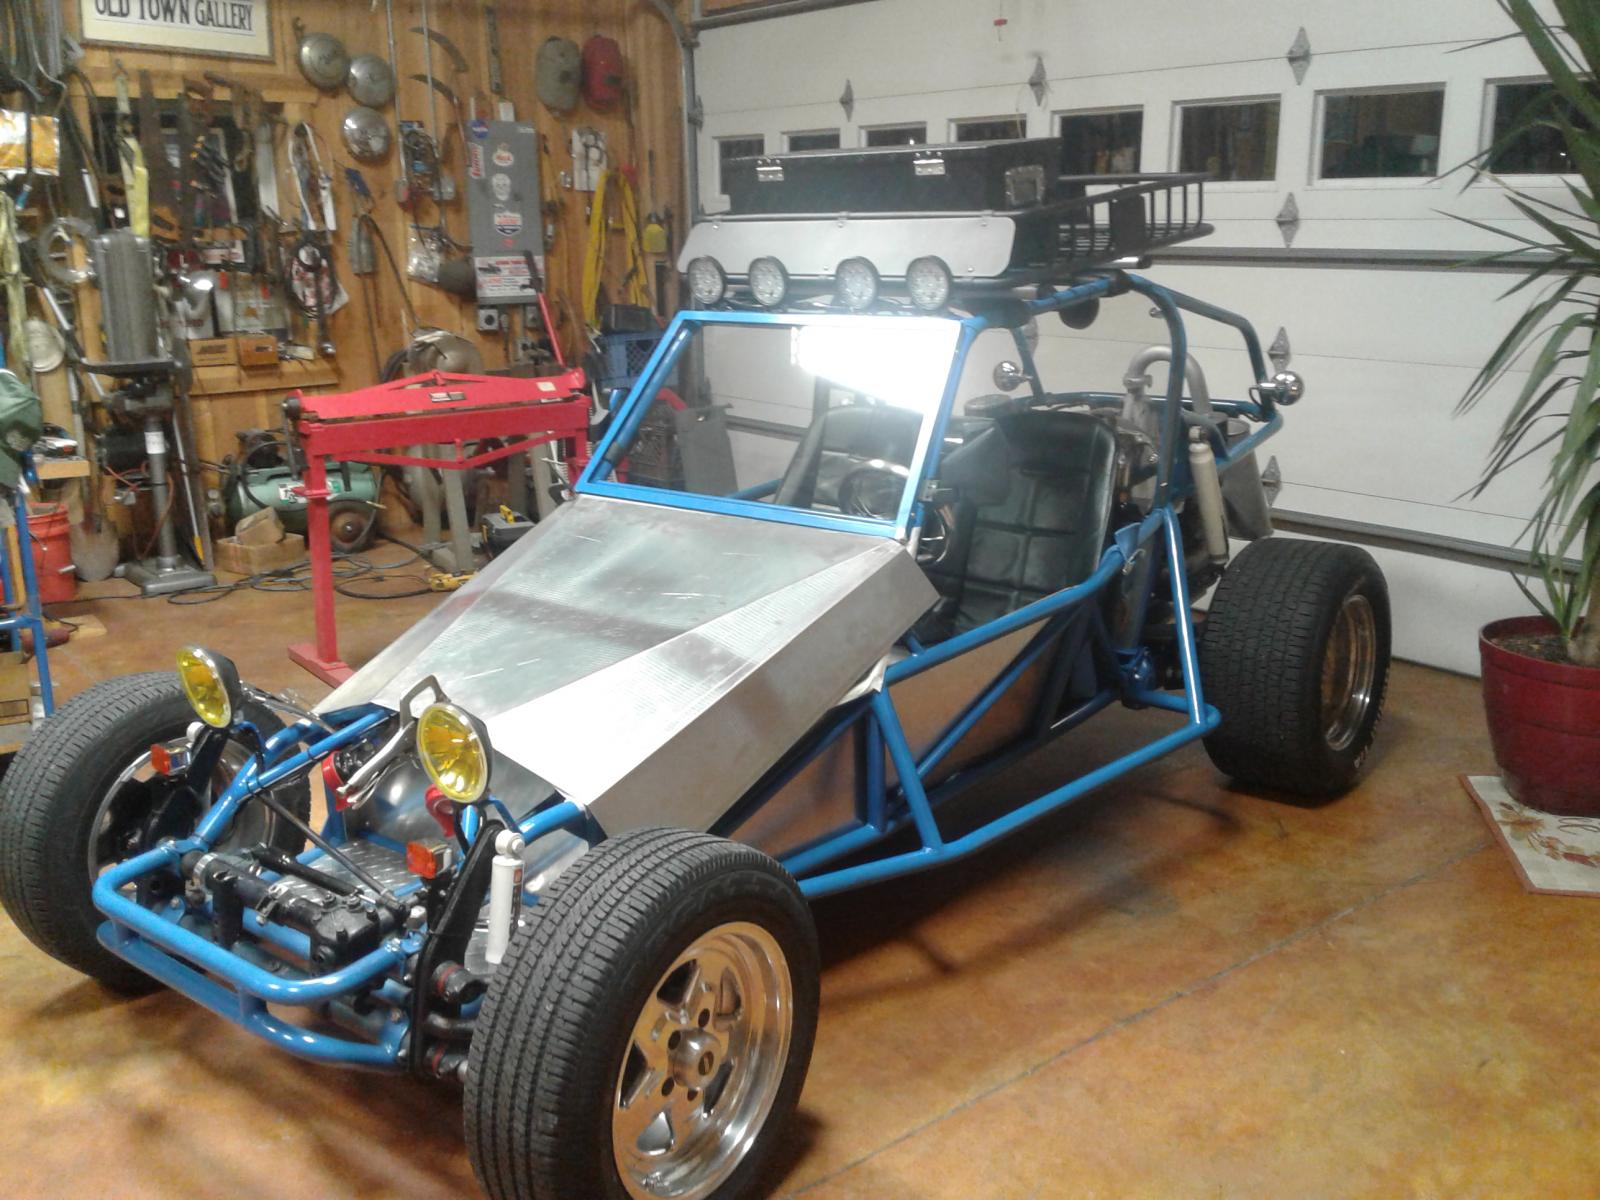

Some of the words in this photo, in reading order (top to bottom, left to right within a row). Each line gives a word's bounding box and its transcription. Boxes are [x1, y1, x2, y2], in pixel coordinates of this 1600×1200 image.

[95, 0, 130, 17] OLD
[139, 0, 190, 24] TOWN
[194, 1, 253, 31] GALLERY
